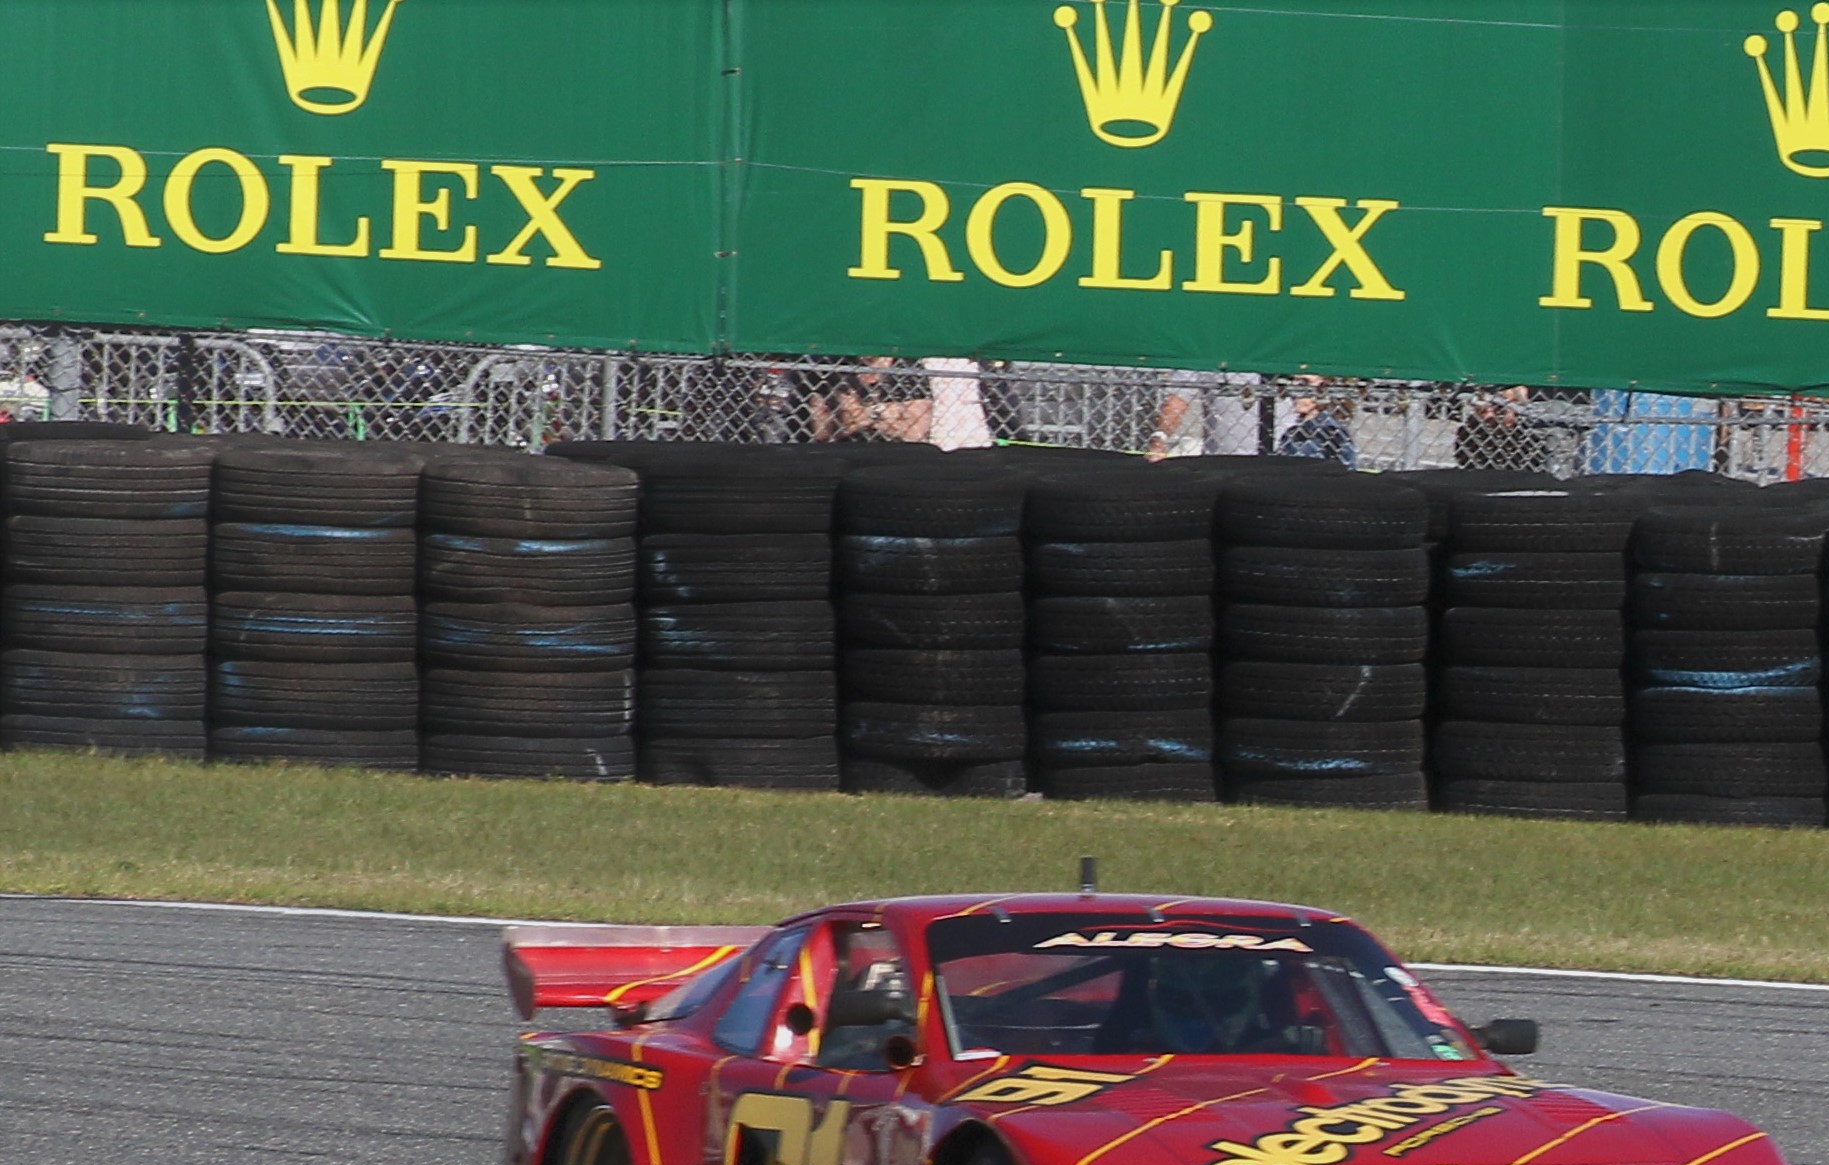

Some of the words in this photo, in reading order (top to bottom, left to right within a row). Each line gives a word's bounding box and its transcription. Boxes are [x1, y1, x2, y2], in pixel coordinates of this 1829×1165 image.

[44, 143, 601, 269] ROLEX
[847, 178, 1405, 300] ROLEX
[1032, 932, 1314, 952] ALEGRA
[953, 1066, 1137, 1106] 91
